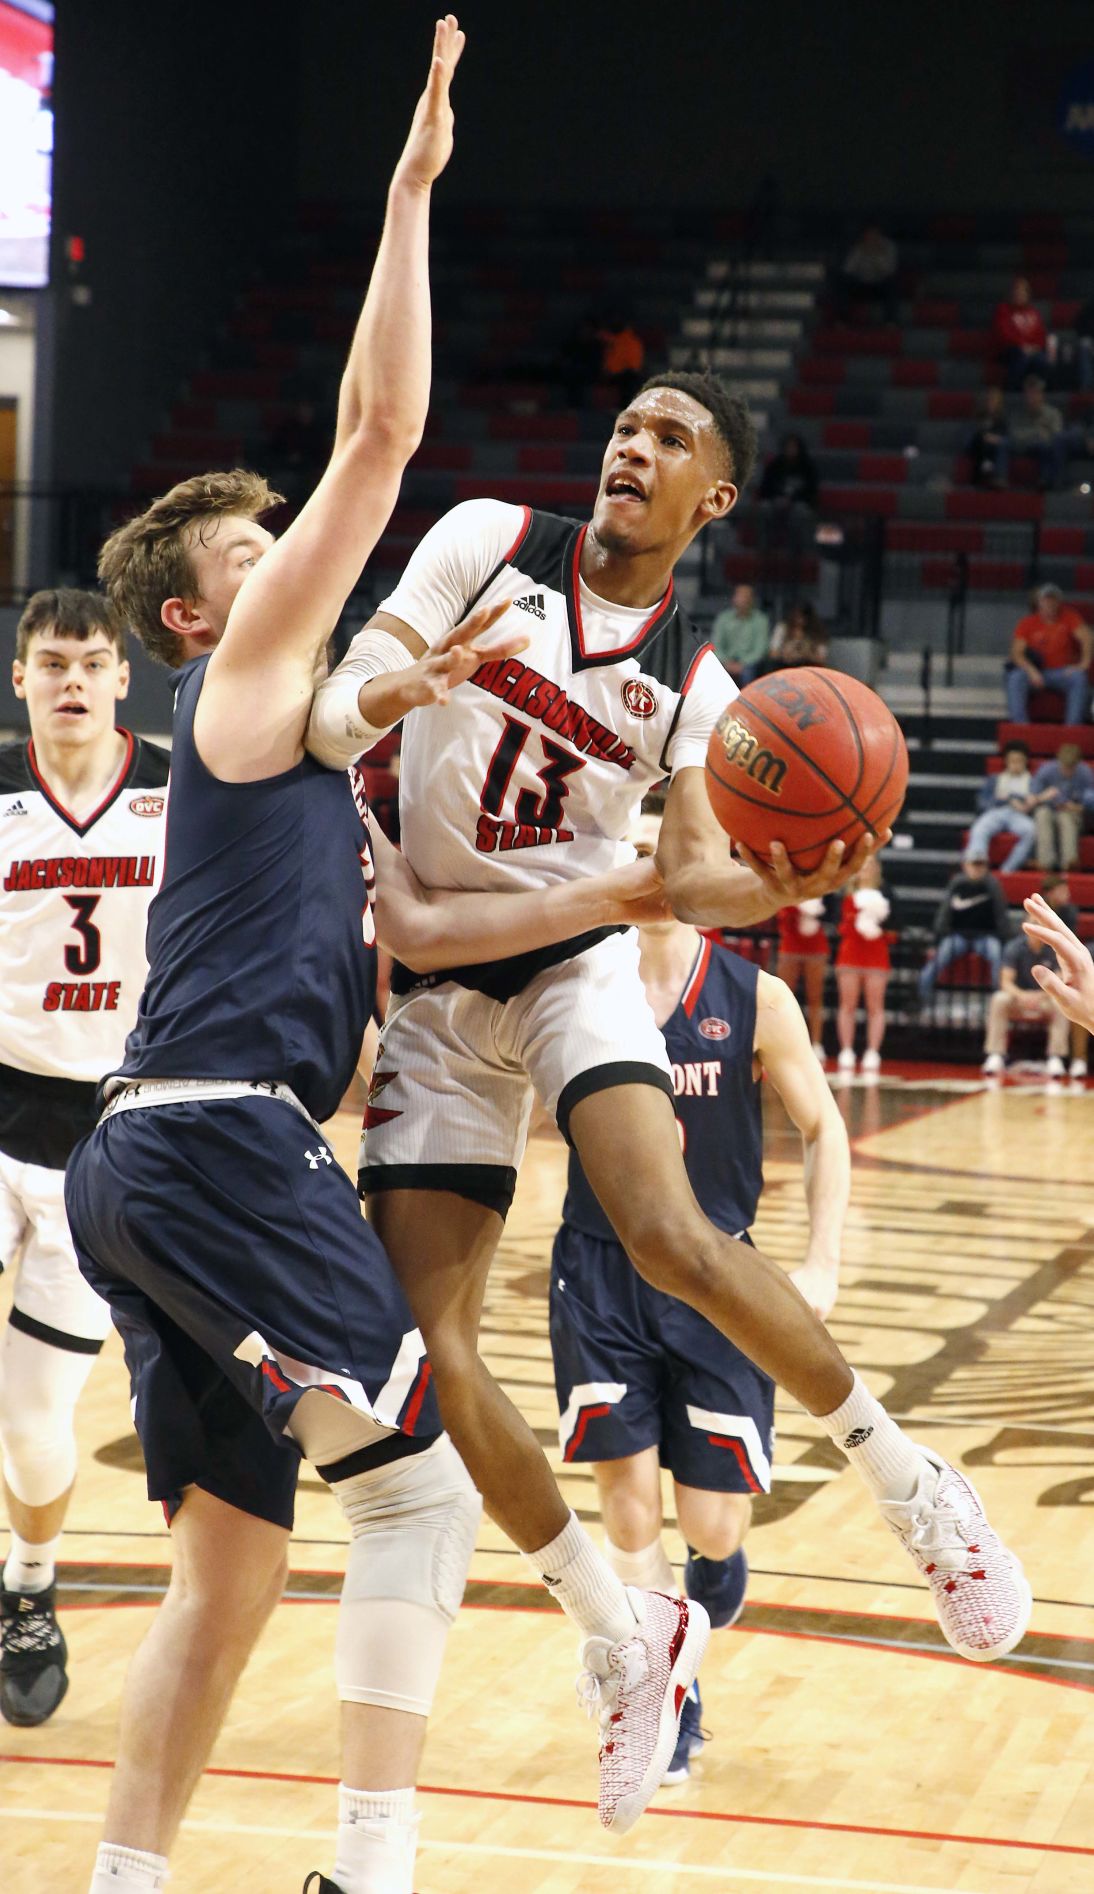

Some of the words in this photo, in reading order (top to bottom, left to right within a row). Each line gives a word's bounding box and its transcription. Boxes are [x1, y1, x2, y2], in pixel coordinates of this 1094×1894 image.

[513, 599, 546, 620] adidas
[468, 658, 637, 770] ACKSONVILLE
[480, 712, 587, 829] 13
[136, 801, 162, 812] OVC
[4, 856, 155, 891] JACKSONVILL
[63, 895, 101, 976] 3
[43, 981, 121, 1012] STATE
[844, 1425, 874, 1449] adidas
